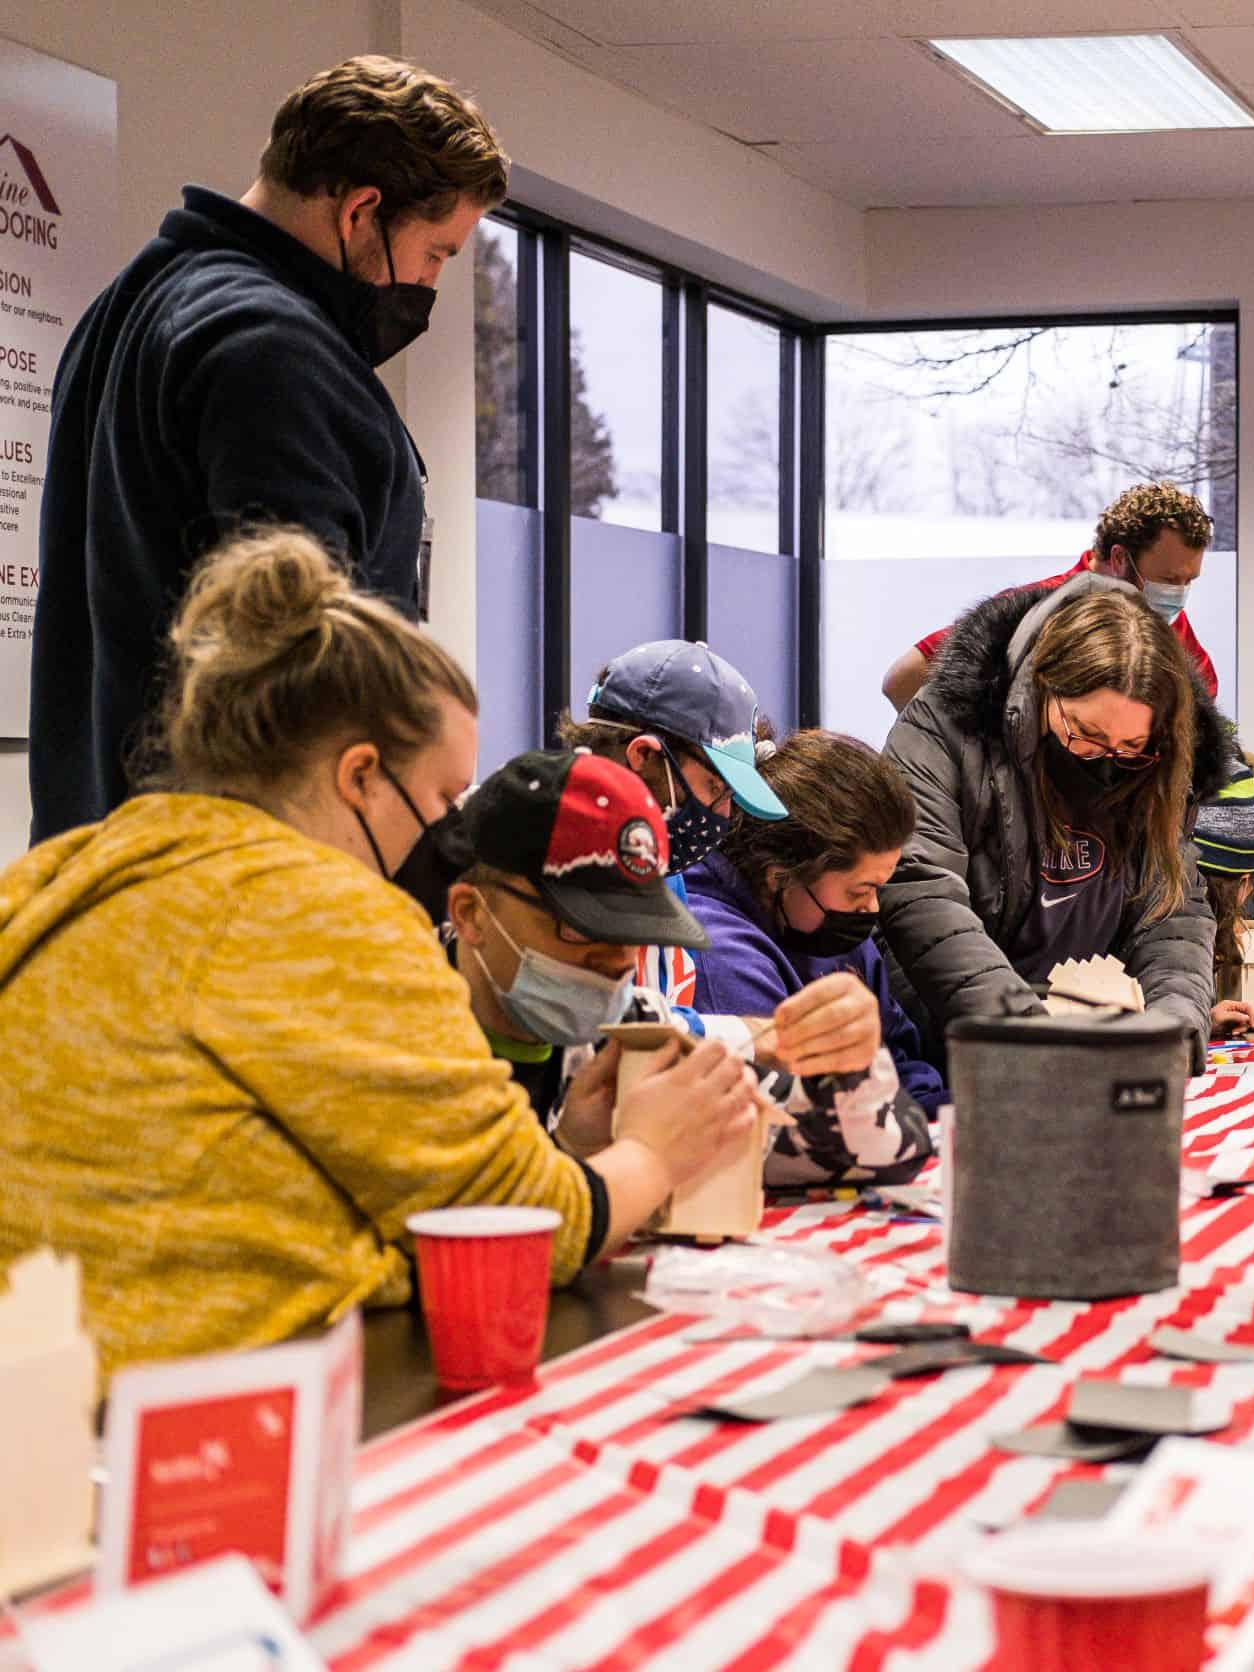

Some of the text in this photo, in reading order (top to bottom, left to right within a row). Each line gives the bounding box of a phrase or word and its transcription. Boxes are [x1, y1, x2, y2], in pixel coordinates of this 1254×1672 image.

[1, 301, 11, 313] for
[14, 306, 25, 316] our
[14, 381, 41, 396] positive
[18, 398, 31, 409] and
[1, 471, 10, 481] to
